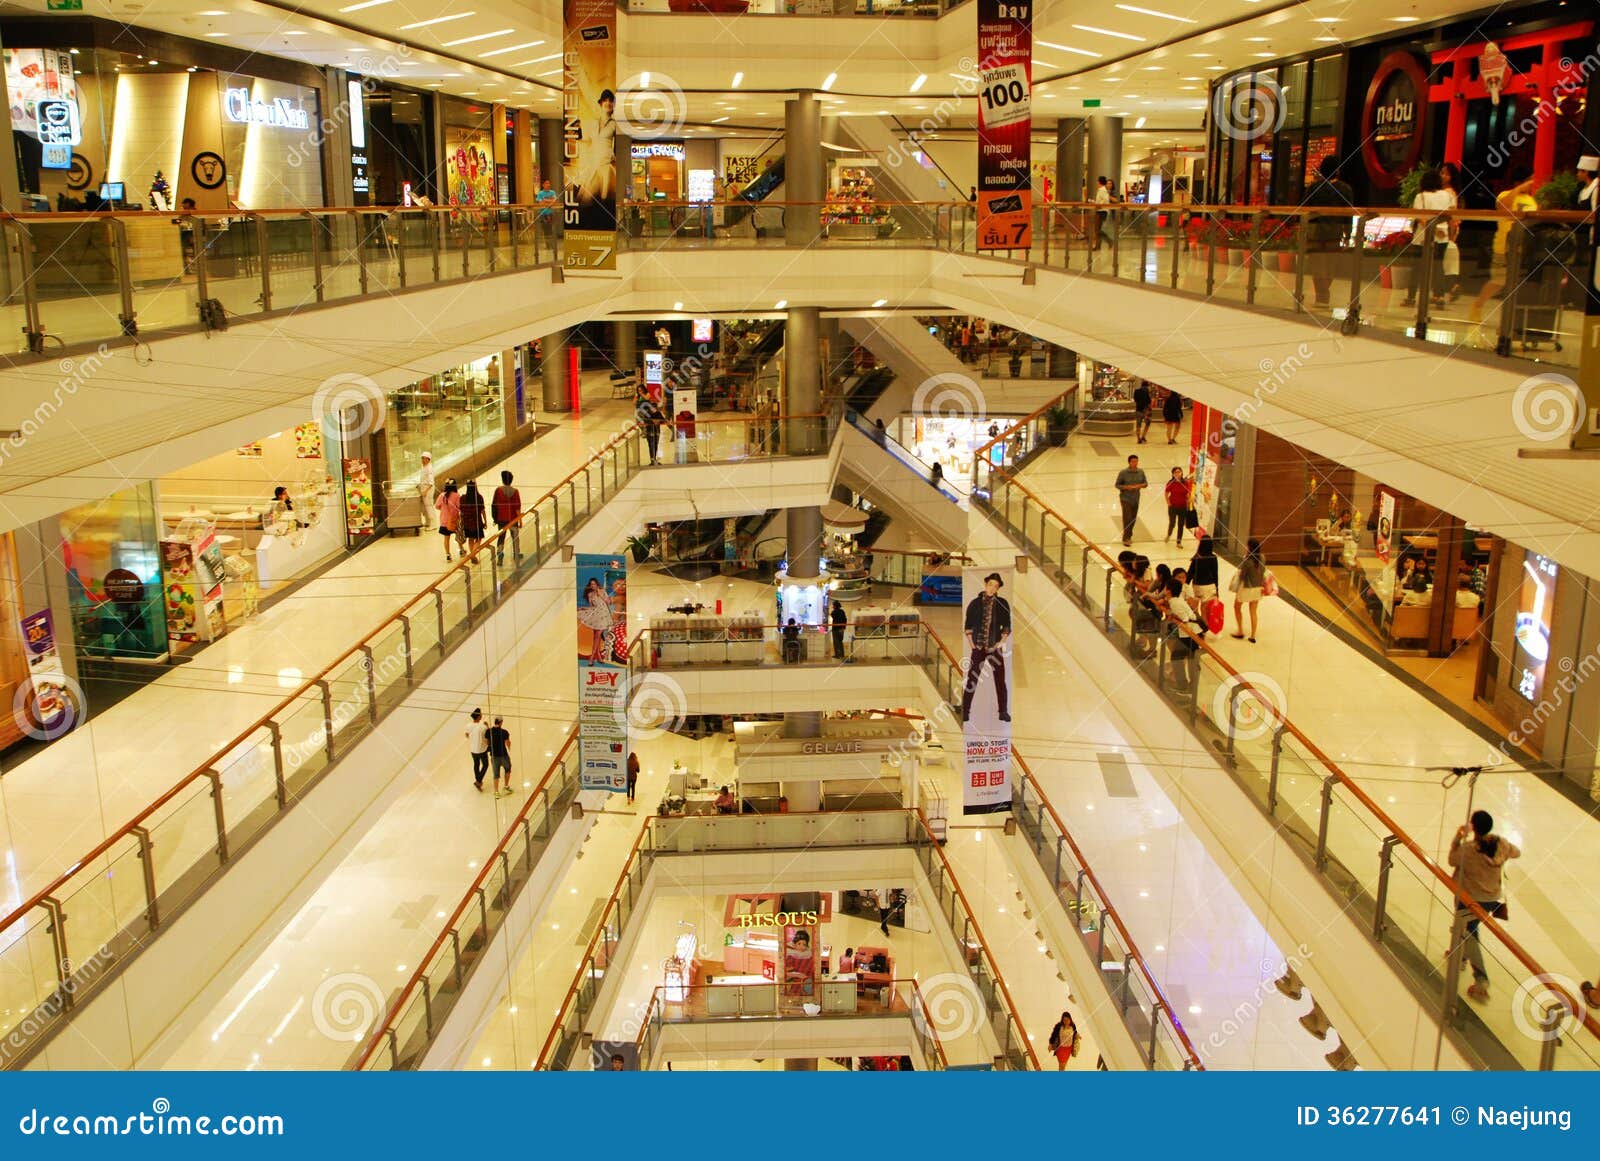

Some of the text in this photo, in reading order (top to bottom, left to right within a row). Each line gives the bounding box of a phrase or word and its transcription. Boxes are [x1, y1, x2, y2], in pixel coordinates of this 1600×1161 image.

[998, 4, 1028, 19] Day
[564, 190, 579, 225] SF
[984, 223, 1028, 245] ชั้น 7
[588, 246, 612, 266] 7
[966, 747, 986, 756] NOW
[988, 746, 1009, 755] OPEN
[737, 911, 818, 929] BISOUS
